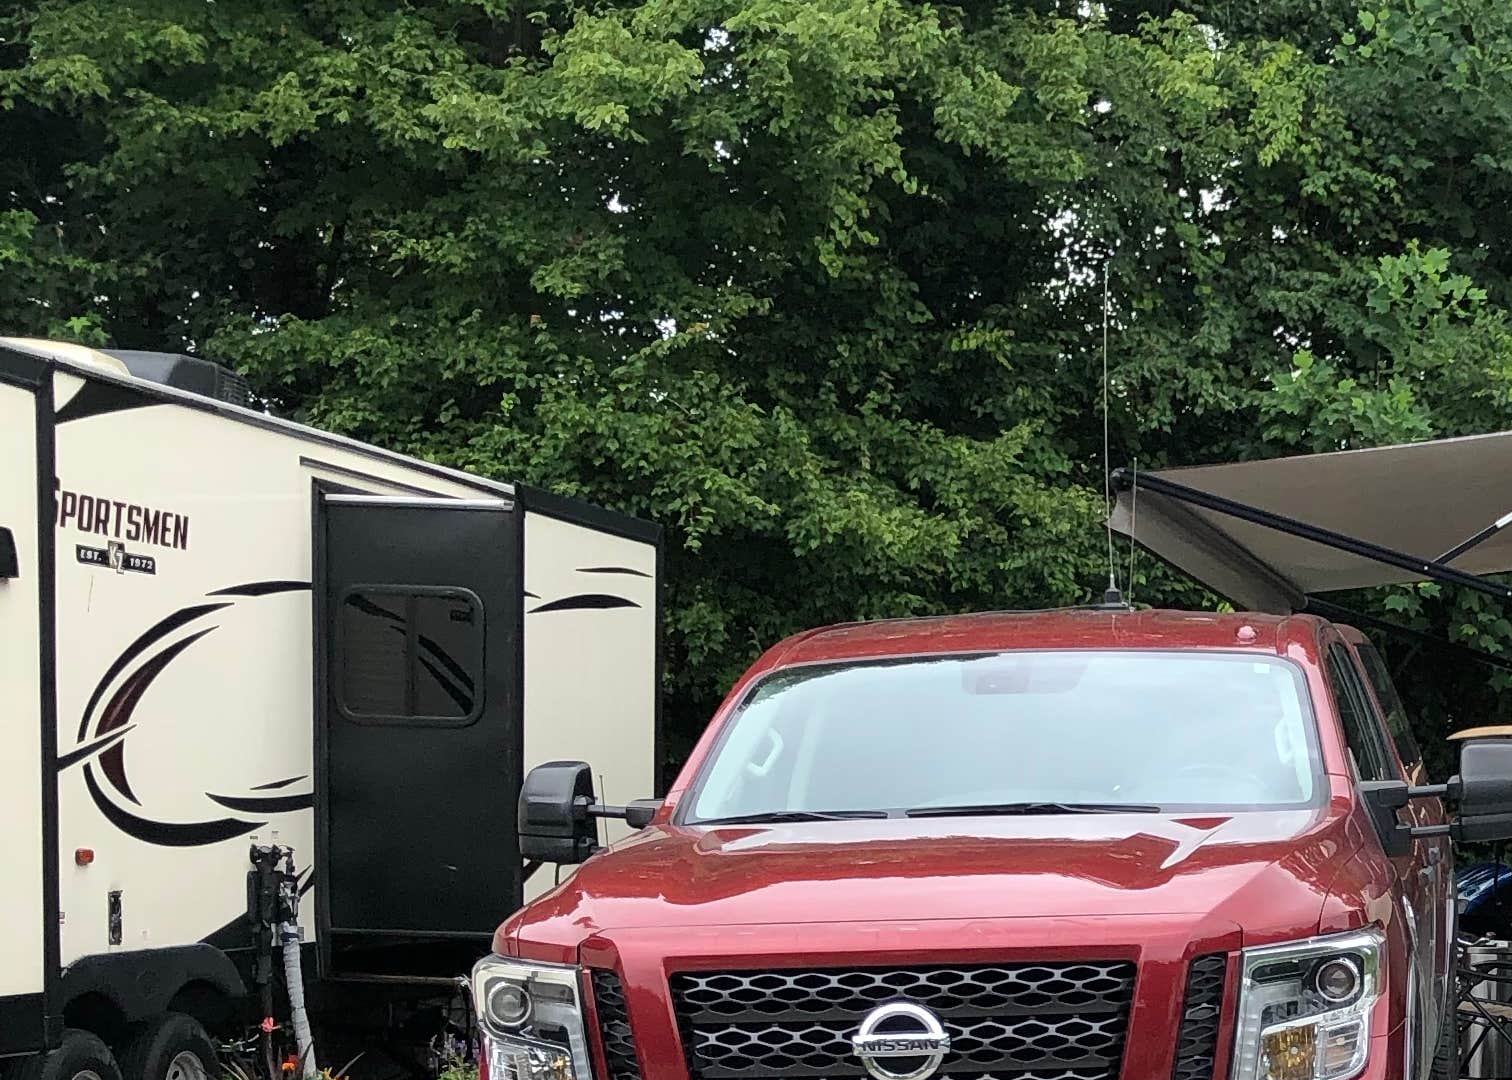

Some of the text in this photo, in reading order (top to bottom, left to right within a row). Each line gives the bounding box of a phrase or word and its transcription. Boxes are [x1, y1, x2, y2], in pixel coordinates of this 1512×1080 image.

[79, 549, 103, 562] EST.
[129, 557, 154, 570] 1972
[863, 1038, 940, 1052] NISSAN
